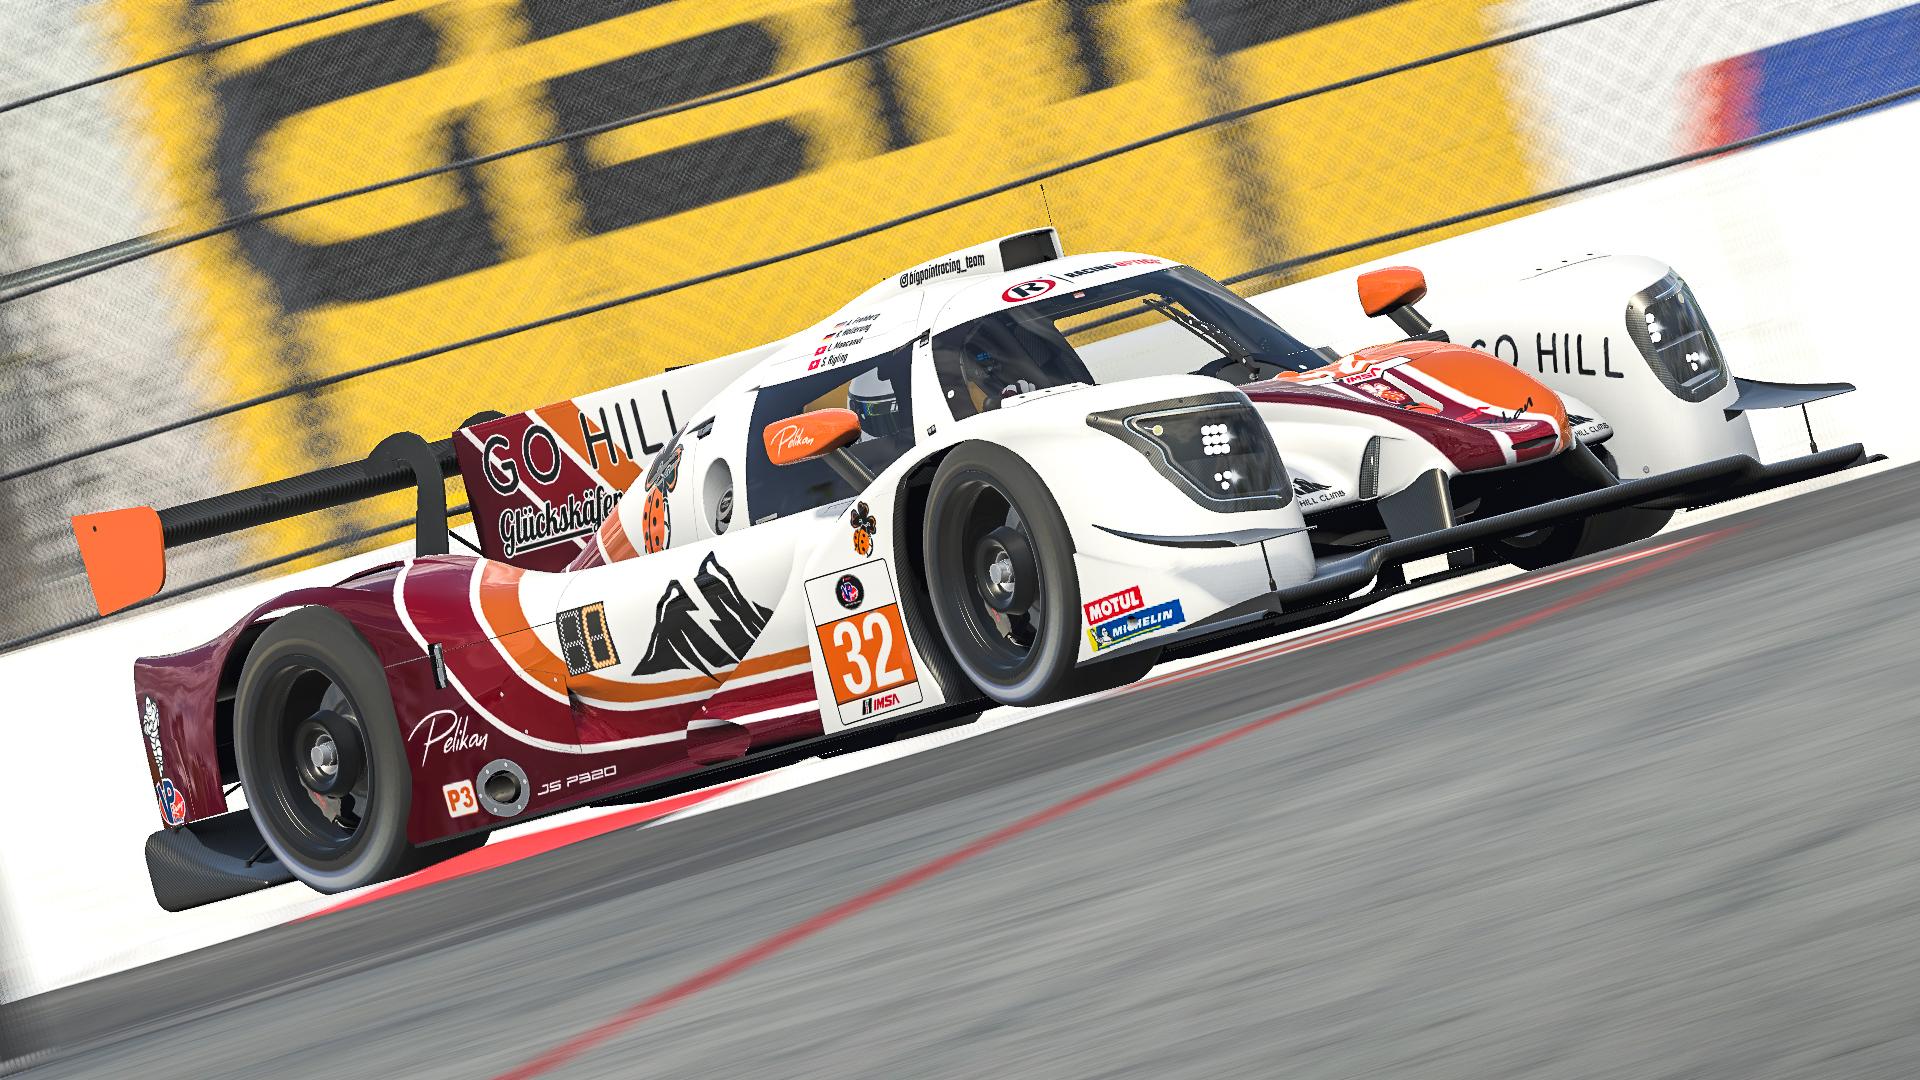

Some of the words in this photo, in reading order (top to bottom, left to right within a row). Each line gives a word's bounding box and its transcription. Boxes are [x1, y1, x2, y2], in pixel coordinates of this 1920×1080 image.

[1063, 263, 1118, 278] RACING
[1471, 334, 1519, 367] O
[1536, 332, 1624, 378] HILL
[482, 424, 562, 506] GO
[1089, 590, 1140, 622] MOTUL
[833, 612, 905, 695] 32
[408, 709, 488, 768] Pelikan
[447, 785, 475, 812] P3
[537, 780, 562, 796] JS
[566, 764, 617, 789] P320
